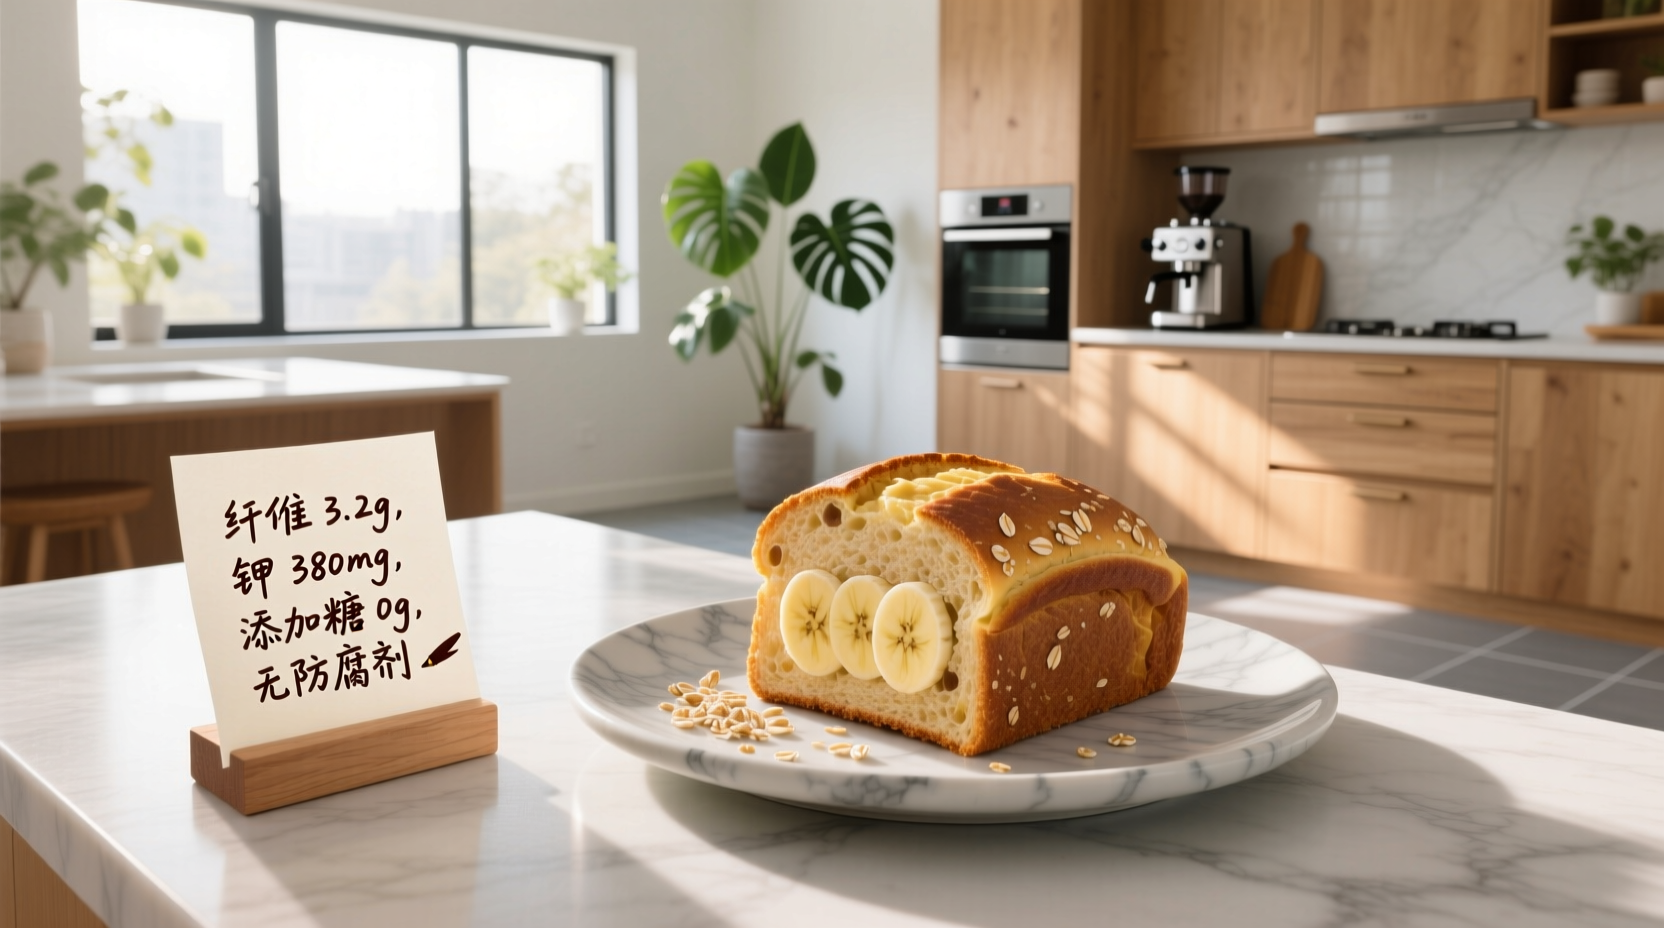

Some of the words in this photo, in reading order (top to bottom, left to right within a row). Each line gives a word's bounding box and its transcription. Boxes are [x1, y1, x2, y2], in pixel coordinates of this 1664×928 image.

[231, 556, 274, 600] 钾
[240, 590, 365, 651] 添加糖
[253, 640, 412, 704] 无防腐剂
